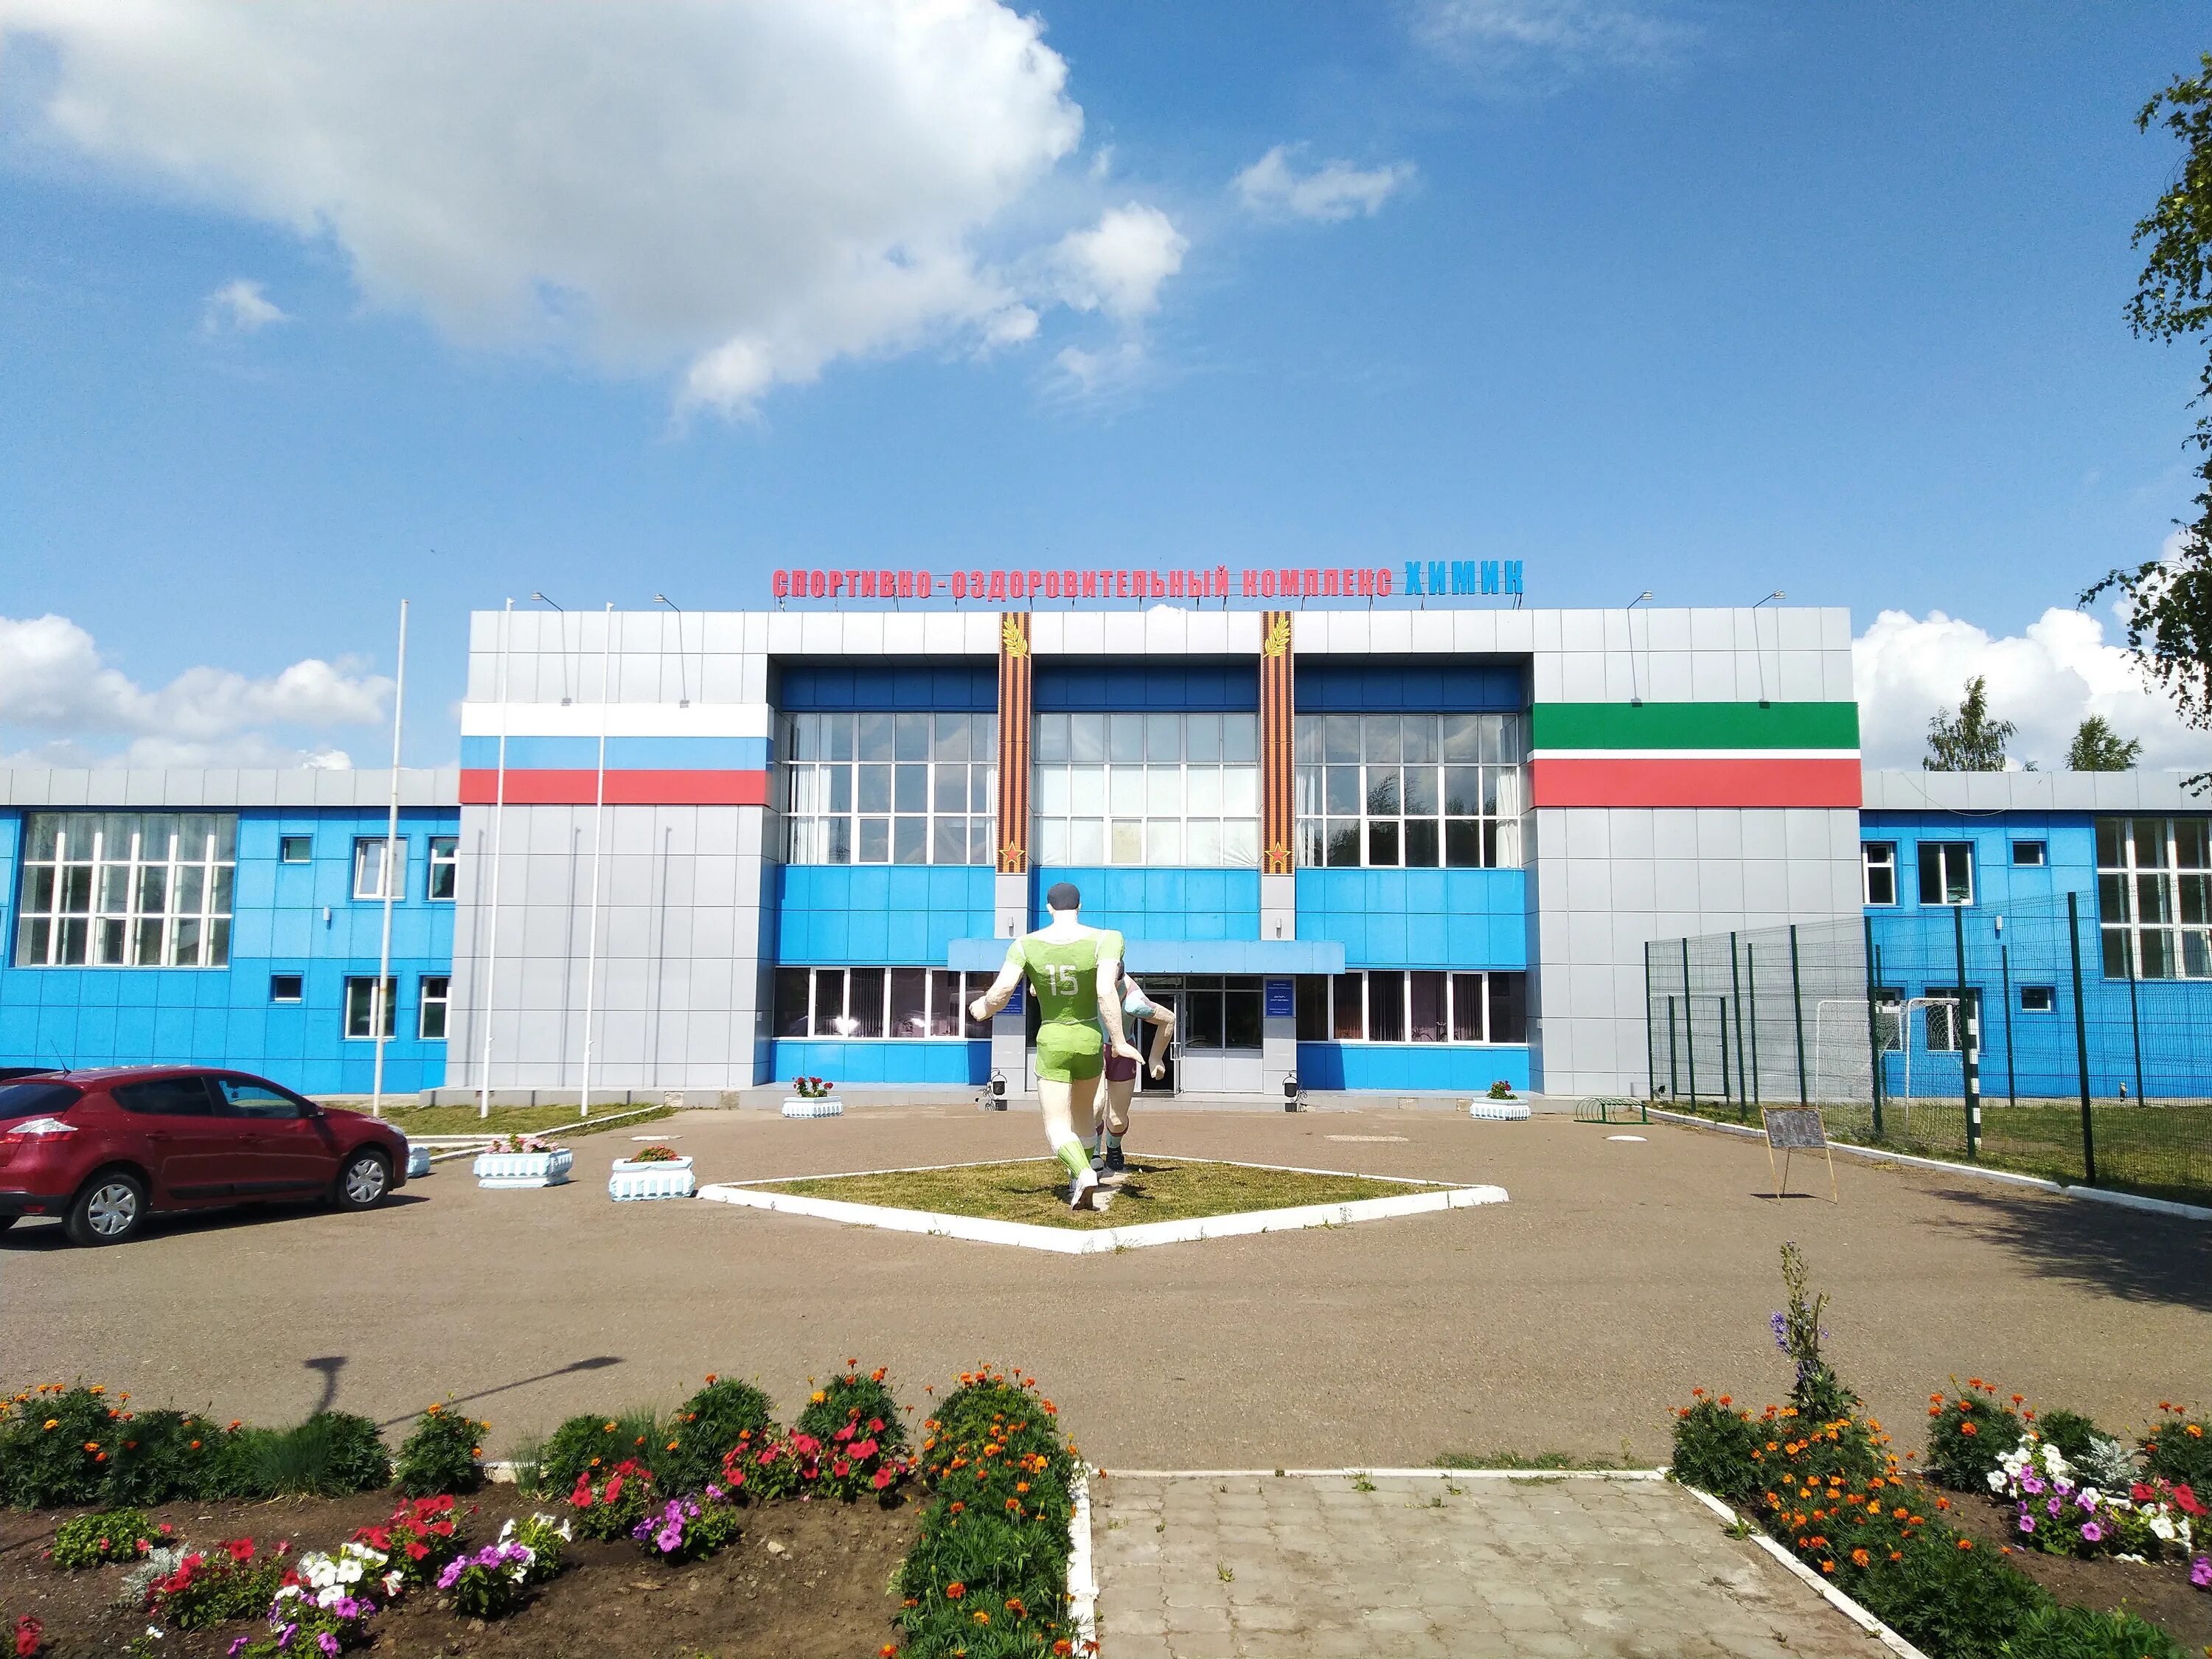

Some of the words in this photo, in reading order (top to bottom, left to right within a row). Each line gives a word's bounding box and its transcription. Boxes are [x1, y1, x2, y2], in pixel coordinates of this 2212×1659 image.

[772, 566, 1229, 601] СПОРТИВНО-ОЗДОРОВИТЕЛЬНЫЙ
[1242, 568, 1393, 597] КОМПЛЕКС
[1404, 560, 1523, 595] ХИМИК
[1044, 964, 1079, 996] 15
